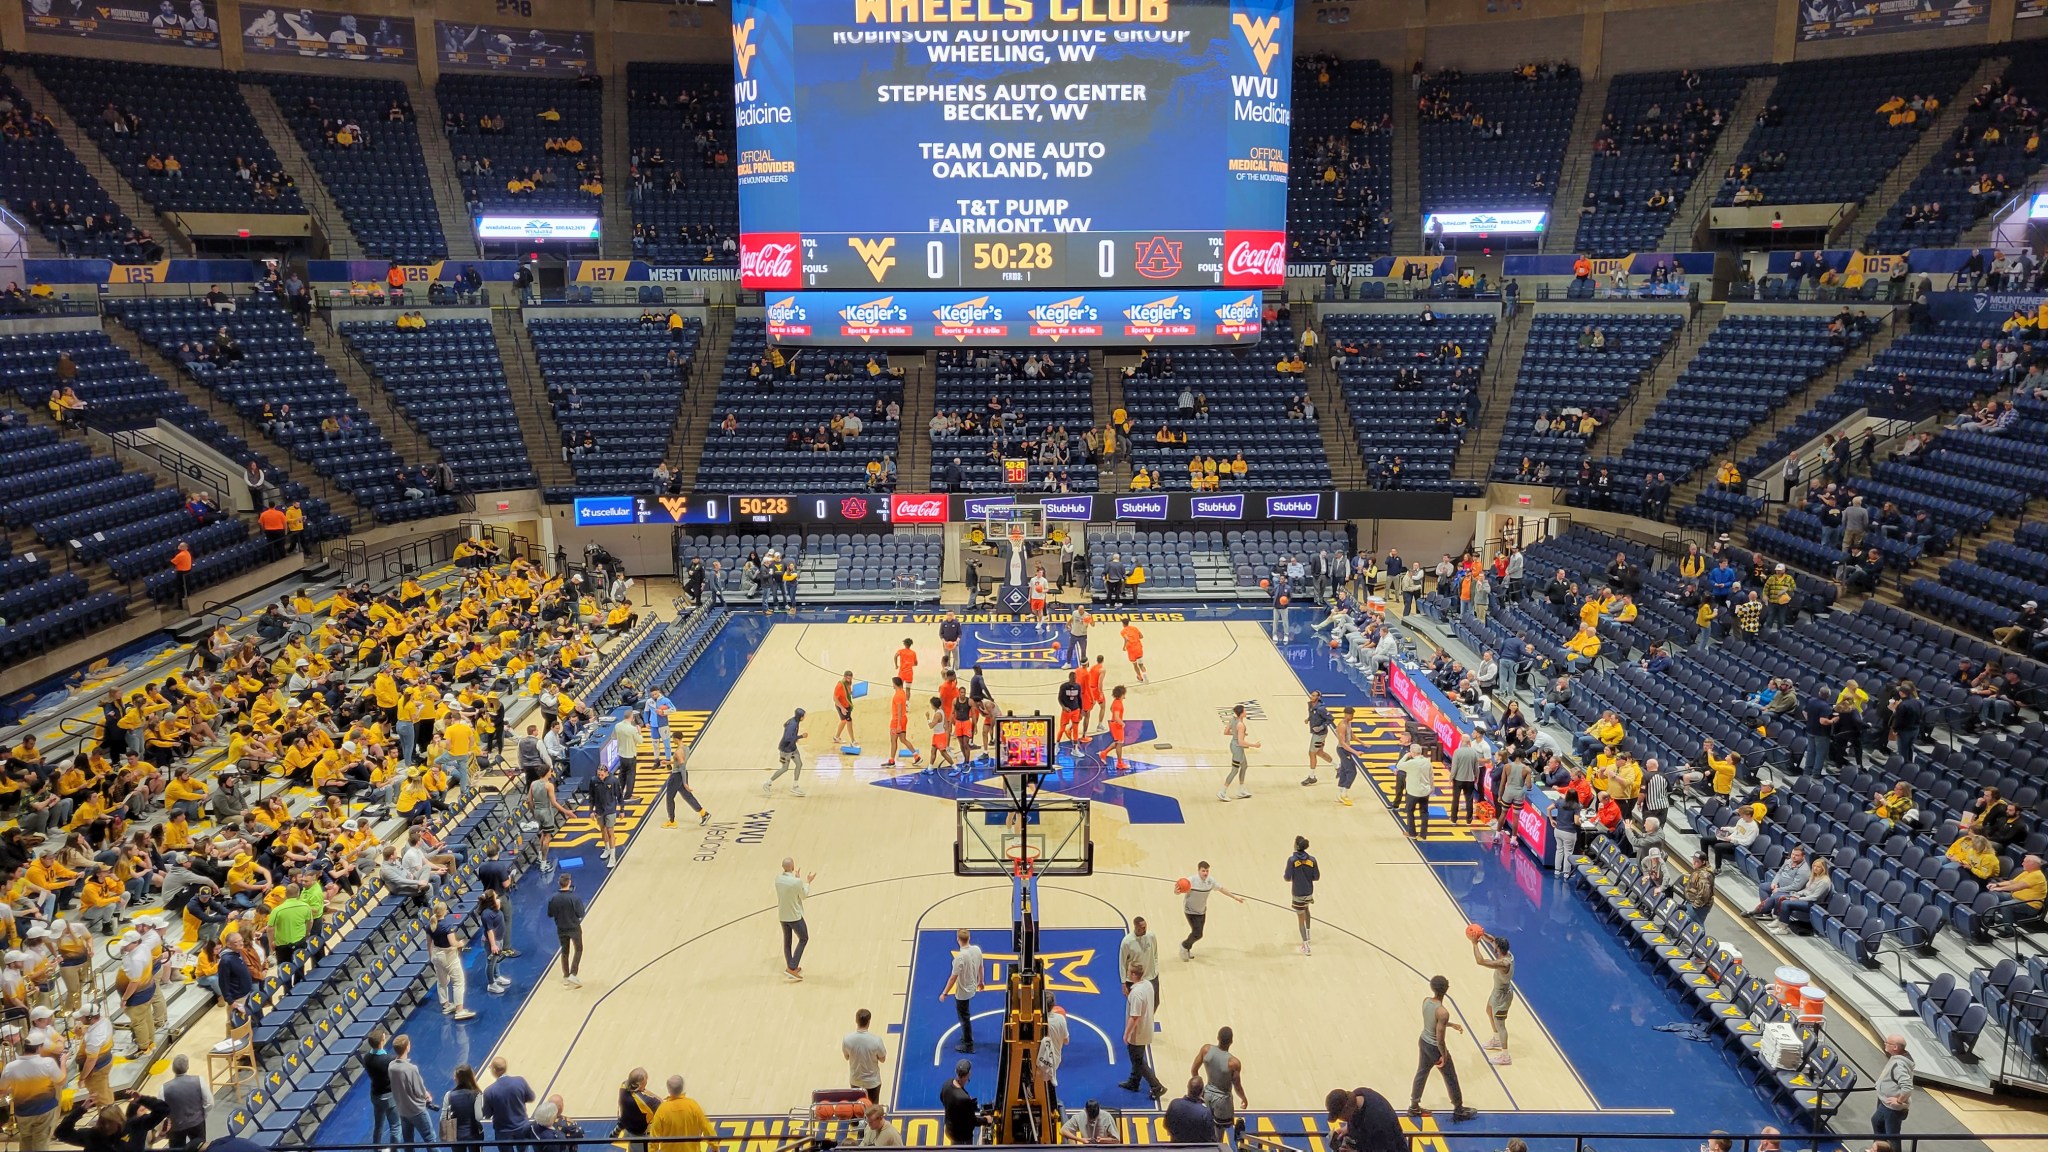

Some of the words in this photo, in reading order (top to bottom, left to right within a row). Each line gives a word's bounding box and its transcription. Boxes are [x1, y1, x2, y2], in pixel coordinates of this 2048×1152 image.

[833, 30, 948, 44] ROBINSON
[955, 29, 1107, 43] AUTOMOTIVE
[926, 44, 1052, 64] WHEELING,
[1057, 44, 1097, 62] WV
[877, 84, 987, 103] STEPHENS
[993, 84, 1058, 102] AUTO
[1064, 84, 1147, 102] CENTER
[1230, 74, 1279, 100] WVU
[943, 103, 1044, 123] BECKLEY,
[1050, 103, 1089, 121] WV
[741, 149, 775, 164] OFFICIAL
[918, 142, 982, 160] TEAM
[988, 142, 1036, 160] ONE
[1041, 141, 1106, 159] AUTO
[1250, 147, 1284, 162] OFFICIAL
[752, 161, 795, 174] PROVIDER
[932, 161, 1049, 180] OAKLAND,
[1055, 161, 1093, 178] MD
[1228, 159, 1268, 172] MEDICAL
[1236, 172, 1246, 181] OF
[1247, 173, 1260, 181] THE
[956, 199, 1000, 217] T&T
[1005, 199, 1069, 216] PUMP
[1052, 217, 1092, 233] WV
[801, 238, 818, 248] TOL
[1207, 237, 1224, 246] TOL
[807, 248, 814, 260] 4
[926, 240, 944, 279] 0
[973, 242, 1054, 270] 50:28
[1098, 239, 1116, 278] 0
[1213, 247, 1220, 259] 4
[802, 264, 829, 273] FOULS
[1197, 263, 1224, 272] FOULS
[1862, 257, 1892, 273] 105
[125, 268, 155, 283] 125
[591, 267, 615, 281] 127
[649, 268, 684, 282] WEST
[809, 274, 816, 286] 0
[1026, 271, 1032, 282] 1
[1213, 272, 1221, 284] 0
[768, 305, 807, 322] Kegler's
[846, 304, 907, 323] Kegler's
[939, 304, 1003, 323] Kegler's
[1035, 304, 1098, 323] Kegler's
[1129, 304, 1191, 323] Kegler's
[1221, 303, 1259, 321] Kegler's
[847, 327, 867, 336] Sports
[869, 327, 880, 336] Bar
[941, 327, 962, 336] Sports
[963, 327, 975, 336] Bar
[1036, 326, 1056, 336] Sports
[1058, 326, 1069, 336] Bar
[1131, 326, 1151, 335] Sports
[1152, 326, 1163, 335] Bar
[591, 506, 630, 517] uscellular
[706, 500, 717, 519] 0
[740, 498, 788, 514] 50:28
[816, 500, 826, 519] 0
[897, 500, 942, 517] Coca-Cola
[1046, 503, 1085, 514] StubHub
[1122, 503, 1161, 513] StubHub
[1197, 502, 1237, 513] StubHub
[1273, 501, 1312, 512] StubHub
[847, 614, 909, 624] WEST
[1002, 721, 1047, 738] 50:28
